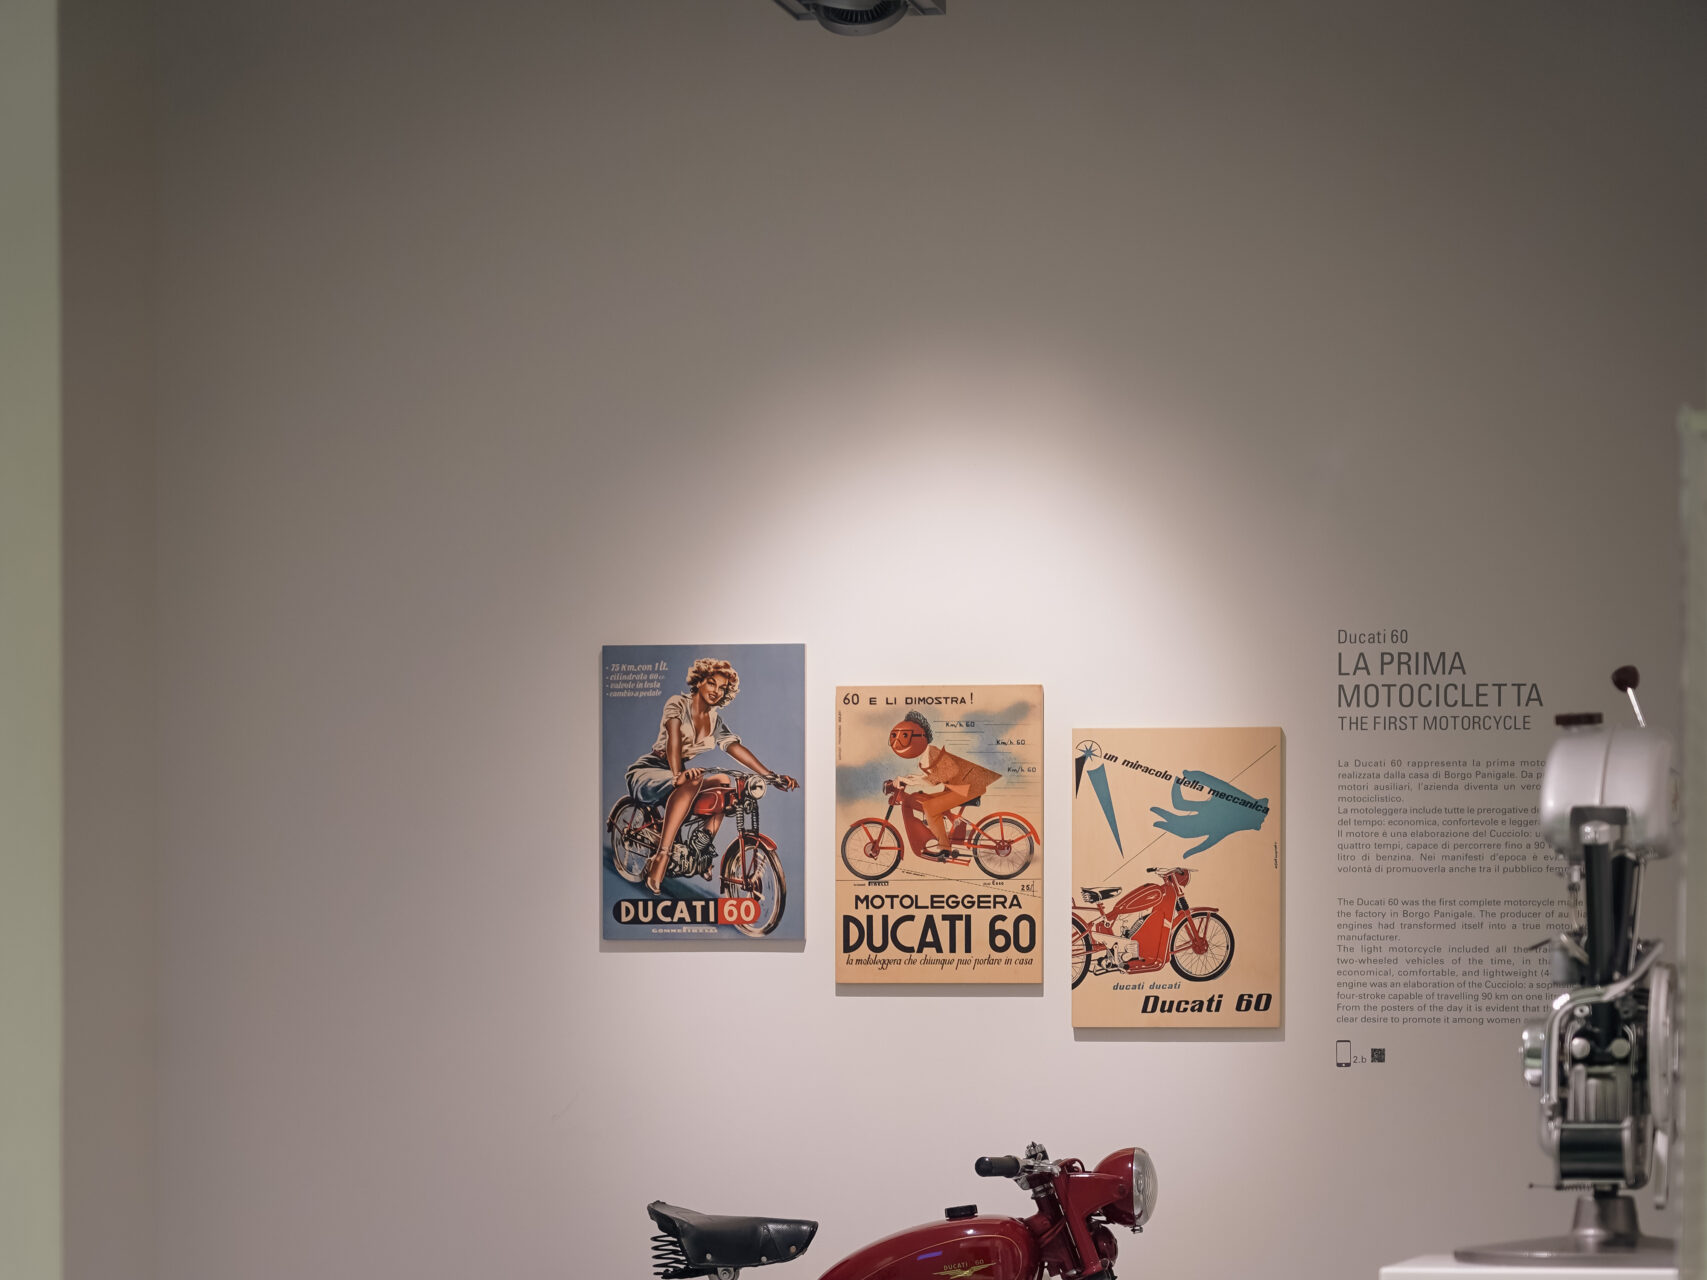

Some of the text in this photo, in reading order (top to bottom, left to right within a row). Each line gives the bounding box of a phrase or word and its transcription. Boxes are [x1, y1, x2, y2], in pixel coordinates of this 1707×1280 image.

[1338, 629, 1408, 644] Ducati 60
[1338, 651, 1467, 676] LA PRIMA
[843, 693, 860, 705] 60
[869, 697, 877, 705] E
[885, 697, 897, 705] LI
[1338, 683, 1544, 708] MOTOCICLETTA
[1338, 715, 1531, 731] THE FIRST MOTORCYCLE
[1354, 759, 1386, 767] Ducati
[1407, 759, 1467, 769] rappresenta
[1486, 759, 1515, 769] prima
[1338, 771, 1381, 779] realizzata
[1383, 771, 1406, 779] dalla
[1444, 771, 1472, 781] Borgo
[1475, 771, 1518, 781] Panigale.
[1103, 752, 1270, 815] un miracolo della meccanica
[1338, 783, 1369, 791] motori
[1374, 783, 1413, 793] ausiliari,
[1464, 783, 1499, 791] diventa
[1338, 795, 1405, 803] motociclistico.
[1351, 806, 1408, 816] motoleggera
[1410, 806, 1442, 814] include
[1444, 806, 1465, 814] tutte
[1477, 806, 1529, 816] prerogative
[1338, 818, 1351, 826] del
[1354, 818, 1386, 828] tempo:
[1388, 818, 1440, 828] economica,
[1442, 818, 1499, 826] confortevole
[1346, 830, 1380, 838] motore
[1410, 830, 1470, 838] elaborazione
[1472, 830, 1487, 838] del
[1489, 830, 1532, 838] Cucciolo:
[1337, 842, 1523, 852] quattro tempi, capace percorrere fino
[1338, 853, 1356, 861] litro
[1376, 853, 1412, 861] benzina.
[1420, 853, 1436, 861] Nei
[1441, 853, 1485, 861] manifesti
[1386, 865, 1446, 875] promuoverla
[1448, 865, 1477, 873] anche
[1479, 865, 1492, 873] tra
[1502, 865, 1543, 875] pubblico
[855, 894, 1022, 909] MOTOLEGGERA
[1337, 898, 1354, 906] The
[1356, 898, 1386, 906] Ducati
[1422, 898, 1437, 906] the
[1439, 898, 1457, 906] first
[1459, 898, 1502, 908] complete
[1504, 898, 1555, 908] motorcycle
[620, 900, 755, 923] DUCATI 60
[1337, 910, 1541, 920] the factory Borgo Panigale. The producer
[1337, 922, 1373, 932] engines
[1378, 922, 1395, 930] had
[1400, 922, 1457, 930] transformed
[1461, 922, 1484, 930] itself
[1489, 922, 1506, 930] into
[1522, 922, 1541, 930] true
[843, 913, 1036, 954] DUCATI 60
[1337, 933, 1401, 941] manufacturer.
[1337, 945, 1355, 953] The
[1361, 945, 1382, 955] light
[1389, 945, 1442, 955] motorcycle
[1448, 945, 1489, 953] included
[1496, 945, 1507, 953] all
[1513, 945, 1527, 953] the
[846, 954, 853, 966] la
[855, 954, 901, 970] motoleggera
[904, 955, 917, 966] che
[920, 954, 954, 970] chiunque
[973, 955, 1002, 970] portare
[1005, 956, 1012, 966] in
[1015, 958, 1034, 966] casa
[1337, 957, 1515, 967] two-wheeled vehicles the time,
[1337, 969, 1395, 979] economical,
[1398, 969, 1458, 979] comfortable,
[1462, 969, 1480, 977] and
[1483, 969, 1538, 979] lightweight
[1113, 981, 1181, 991] ducati ducati
[1337, 981, 1526, 991] engine elaboration the Cucciolo:
[1337, 992, 1386, 1000] four-stroke
[1388, 992, 1423, 1002] capable
[1437, 992, 1479, 1002] travelling
[1141, 993, 1272, 1014] Ducati 60
[1337, 1004, 1361, 1012] From
[1363, 1004, 1378, 1012] the
[1381, 1004, 1414, 1014] posters
[1429, 1004, 1444, 1012] the
[1447, 1004, 1464, 1014] day
[1485, 1004, 1520, 1012] evident
[1522, 1004, 1540, 1012] that
[1337, 1016, 1359, 1024] clear
[1361, 1016, 1388, 1024] desire
[1402, 1016, 1441, 1026] promote
[1452, 1018, 1484, 1026] among
[943, 1262, 968, 1271] DUCATI
